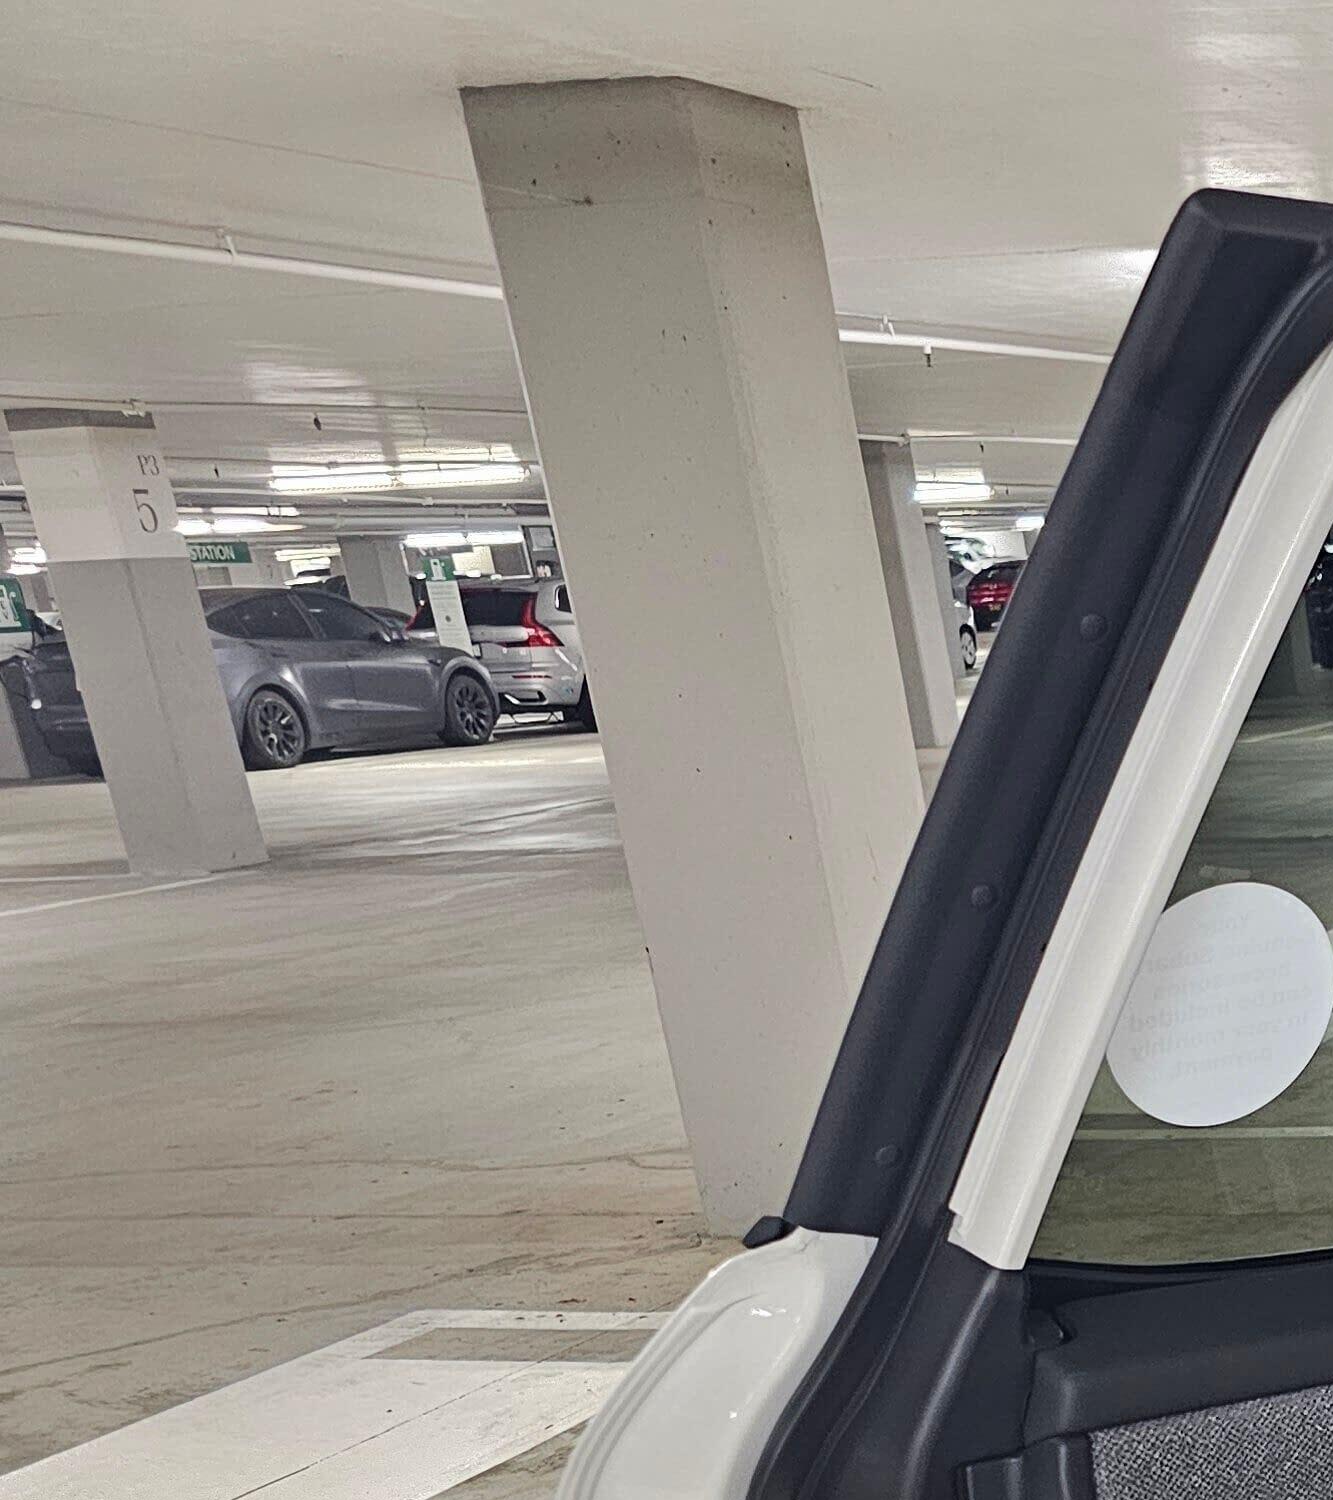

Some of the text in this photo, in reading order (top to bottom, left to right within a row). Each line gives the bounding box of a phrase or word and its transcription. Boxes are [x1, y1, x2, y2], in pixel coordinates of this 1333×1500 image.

[137, 454, 160, 476] P3
[132, 488, 159, 534] 5
[190, 544, 235, 561] STATION
